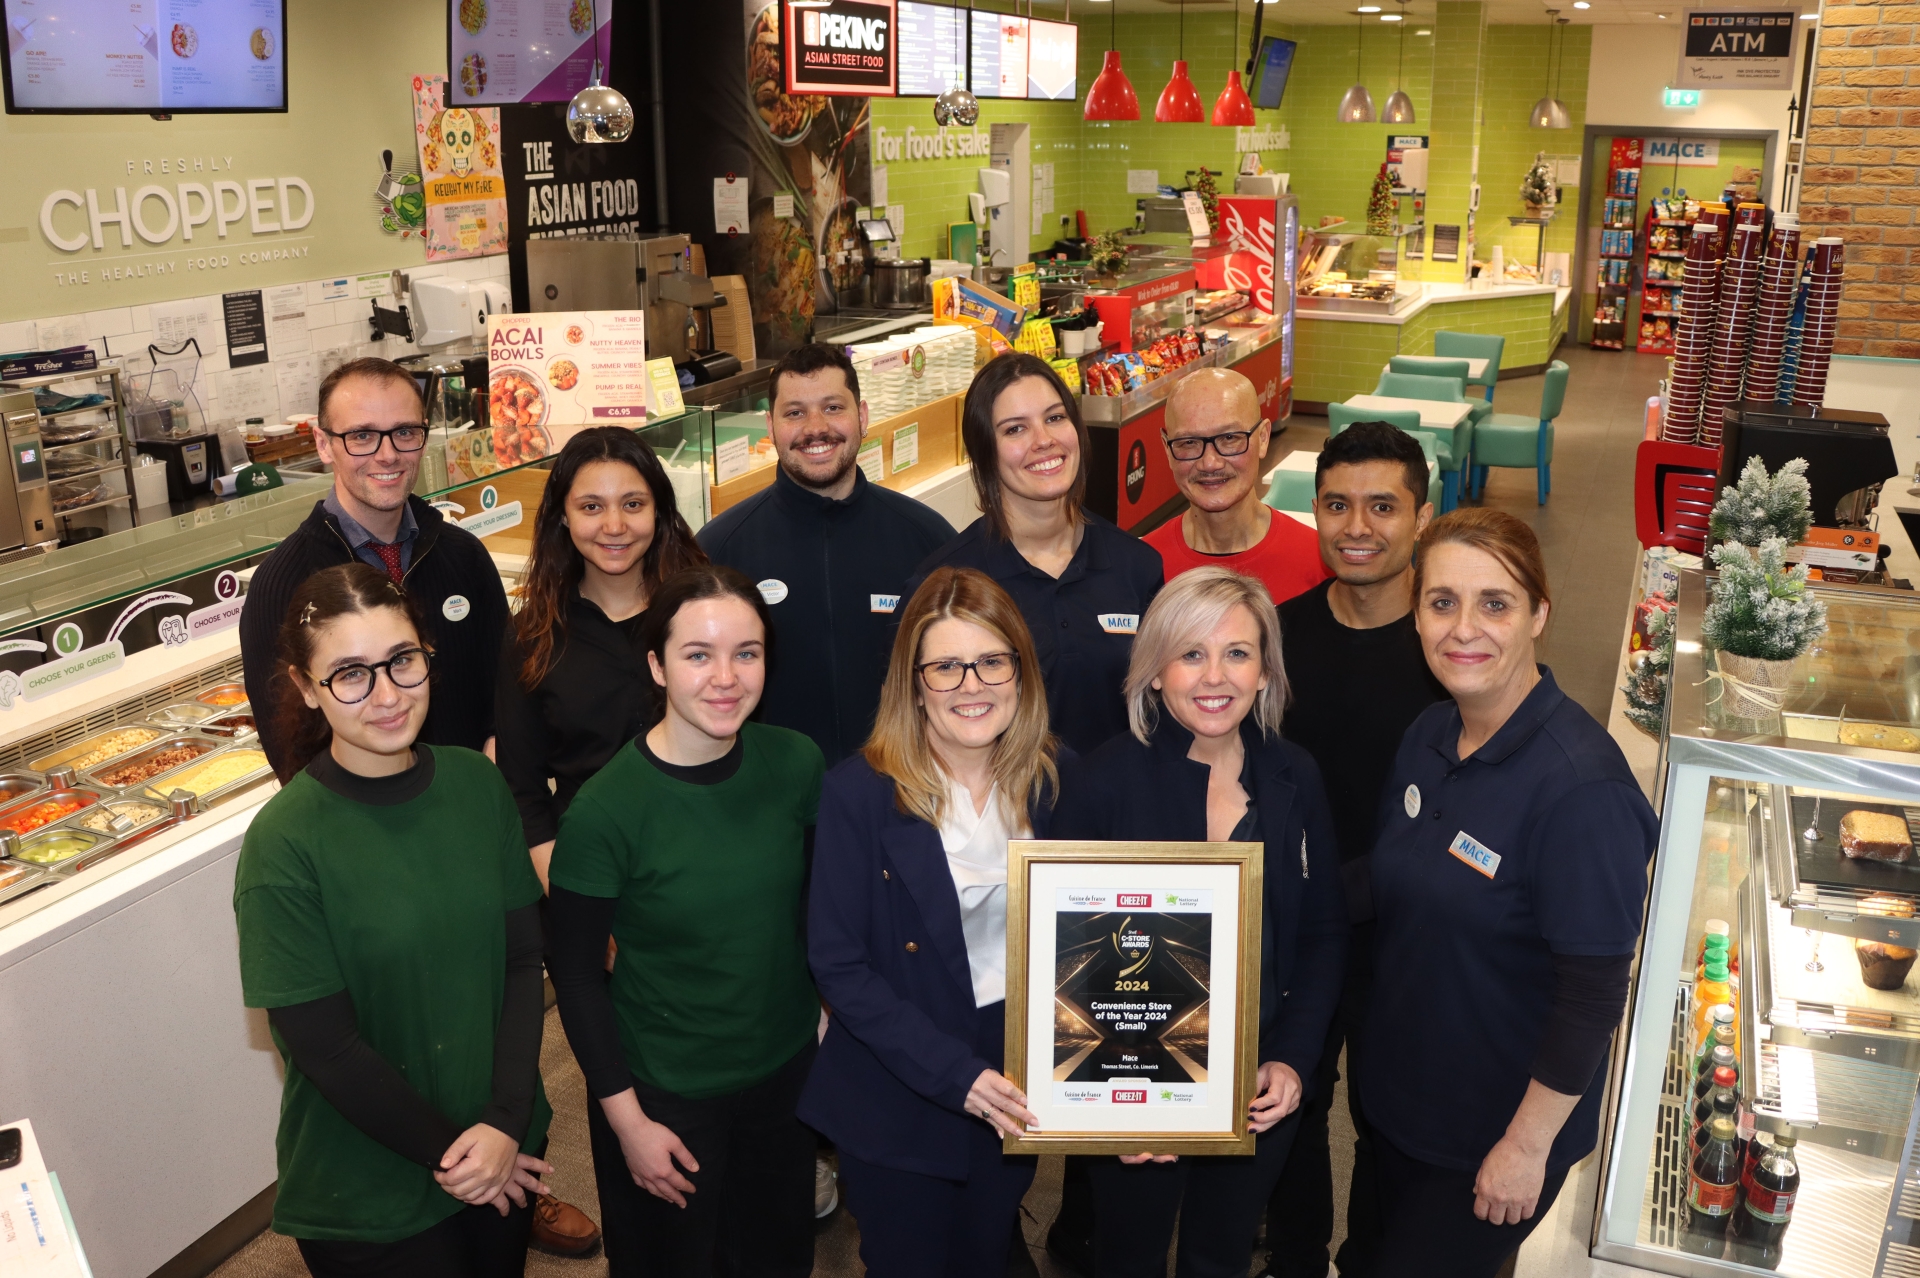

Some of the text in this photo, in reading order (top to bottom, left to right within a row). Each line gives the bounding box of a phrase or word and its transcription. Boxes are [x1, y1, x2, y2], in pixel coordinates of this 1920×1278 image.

[820, 12, 884, 51] PEKING
[1709, 33, 1766, 52] ATM
[805, 51, 884, 68] ASIAN STREET FOOD
[876, 124, 990, 160] for food's sake
[1650, 141, 1705, 158] MACE
[126, 156, 234, 175] FRESHLY
[523, 141, 554, 172] THE
[434, 181, 474, 197] RELIGHT MY
[528, 178, 639, 226] ASIAN FOOD
[39, 176, 315, 251] CHOPPED
[55, 246, 310, 286] THE HEALTHY FOOD COMPANY
[491, 327, 543, 346] ACAI
[491, 347, 544, 361] BOWLS
[1127, 466, 1145, 487] PEKING
[483, 518, 496, 527] YOUR
[496, 509, 518, 522] DRESSING
[222, 578, 232, 594] 2
[194, 607, 240, 629] CHOOSE YOUR
[1107, 617, 1132, 628] MACE
[63, 631, 70, 647] 1
[29, 651, 116, 689] CHOOSE YOUR GREENS
[1459, 839, 1491, 867] MACE
[1114, 980, 1150, 991] 2024
[1090, 1002, 1172, 1010] Convenience Store
[1095, 1011, 1167, 1020] of the Year 2024
[1115, 1021, 1147, 1031] (Small)
[1122, 1054, 1139, 1062] Mace
